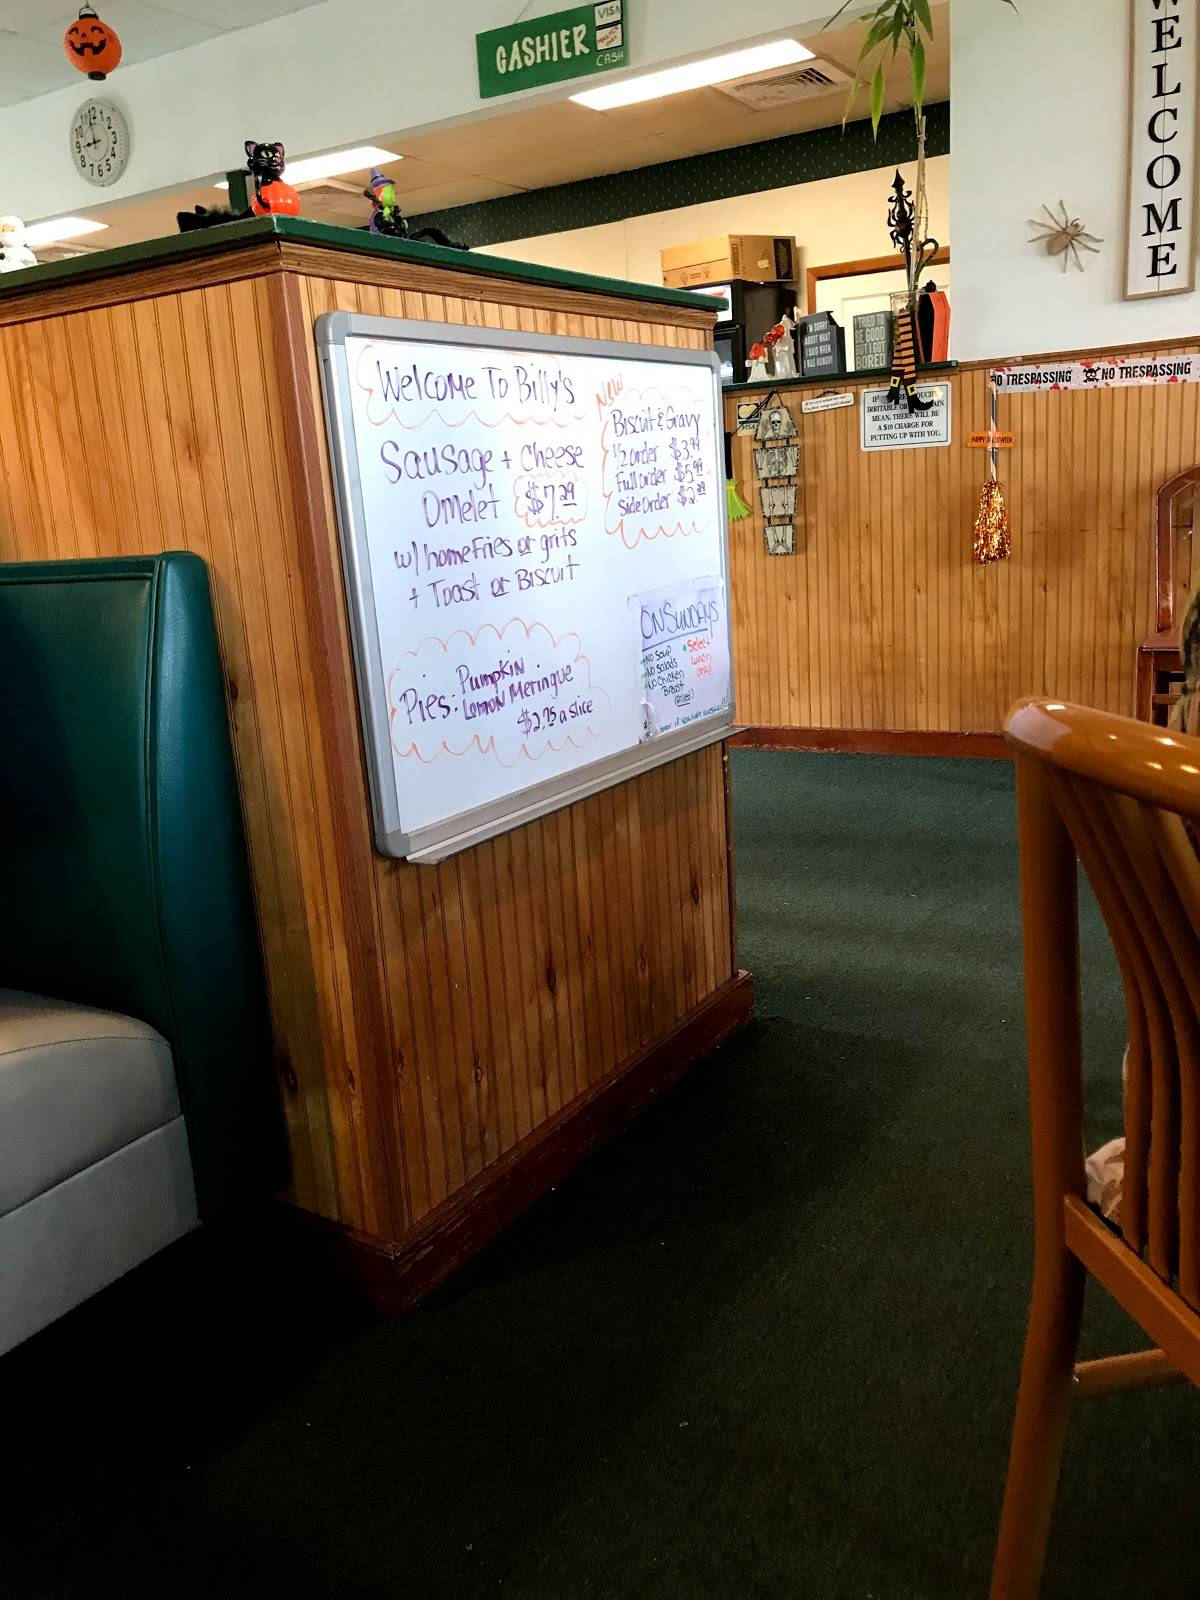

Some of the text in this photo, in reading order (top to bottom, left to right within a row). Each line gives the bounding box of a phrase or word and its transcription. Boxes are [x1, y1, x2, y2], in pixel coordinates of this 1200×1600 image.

[598, 5, 621, 19] VISA
[596, 51, 624, 66] CASH
[100, 109, 104, 121] 1
[106, 116, 112, 130] 2
[112, 131, 117, 144] 3
[1142, 0, 1182, 278] ELCOME
[76, 140, 81, 154] 9
[111, 146, 116, 159] 4
[81, 155, 86, 168] 8
[106, 159, 111, 172] 5
[89, 164, 94, 176] 7
[98, 164, 103, 177] 6
[876, 314, 885, 326] TO
[804, 331, 831, 345] ABOUT WHAT
[855, 326, 886, 344] BE GOOD
[855, 344, 868, 356] BUT
[872, 341, 886, 353] GOT
[855, 353, 886, 370] BORED
[1006, 369, 1072, 386] TRESPASSING
[1101, 361, 1192, 380] NO TRESPASSING
[481, 366, 508, 400] To
[514, 363, 575, 412] Billy's
[867, 404, 898, 413] IRRITABLE
[893, 412, 913, 421] THERE
[914, 410, 929, 418] WILL
[931, 409, 939, 417] BE
[610, 406, 656, 437] Biscuit
[666, 405, 700, 438] Gravy
[883, 423, 893, 431] $10
[894, 421, 920, 430] CHARGE
[921, 420, 934, 428] FOR
[870, 433, 898, 441] PUTTING
[381, 440, 585, 490] Sausage + Cheese
[616, 471, 638, 493] Full
[423, 483, 500, 527] Omelet
[618, 496, 641, 516] Side
[517, 536, 536, 556] or
[540, 527, 577, 563] grits
[409, 555, 580, 608] + Toast or Biscuit
[559, 709, 567, 724] a
